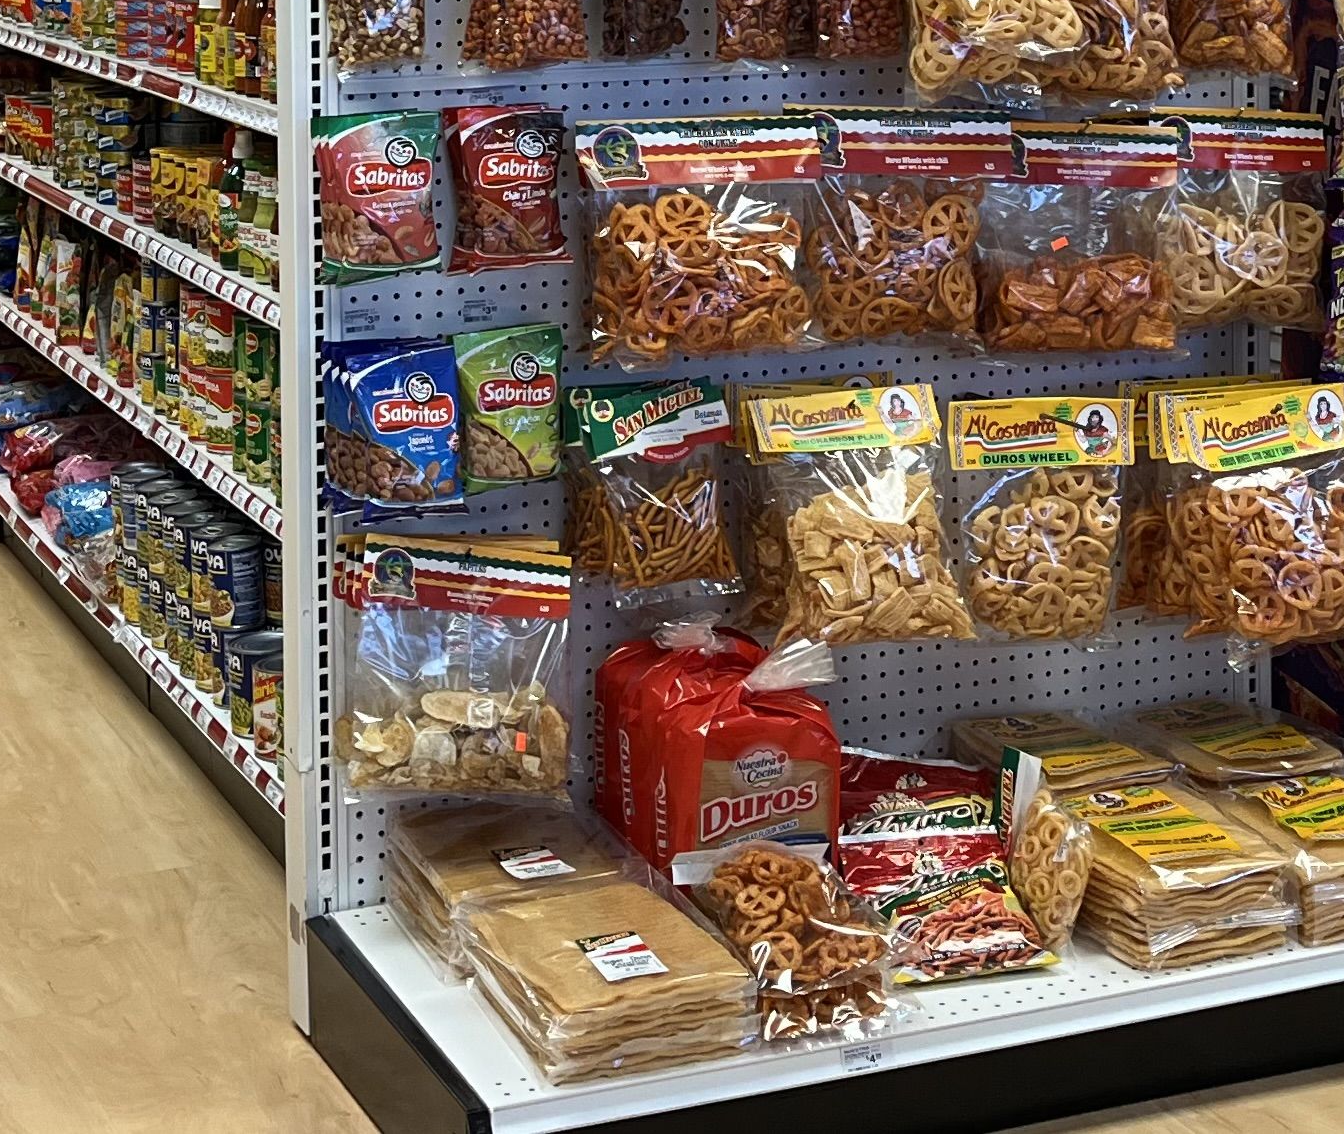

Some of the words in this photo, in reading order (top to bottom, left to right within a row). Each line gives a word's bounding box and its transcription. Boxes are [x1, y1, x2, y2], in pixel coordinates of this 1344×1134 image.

[354, 165, 425, 187] Sabritas
[484, 383, 551, 402] Sabritas
[378, 404, 448, 423] Sabritas
[613, 414, 643, 445] SAN
[643, 386, 704, 423] MIGUEL
[694, 408, 723, 420] Botanas
[771, 403, 790, 425] Mi
[965, 413, 987, 439] Mi
[1202, 416, 1221, 442] Mi
[794, 435, 854, 446] CHICHARRON
[857, 433, 885, 443] PLAIN
[983, 452, 1026, 465] DUROS
[1029, 451, 1073, 464] WHEEL
[207, 554, 224, 571] YA
[736, 755, 776, 772] Nuestra
[747, 767, 783, 784] Cocina
[701, 781, 818, 841] Duros
[778, 820, 799, 833] SNACK
